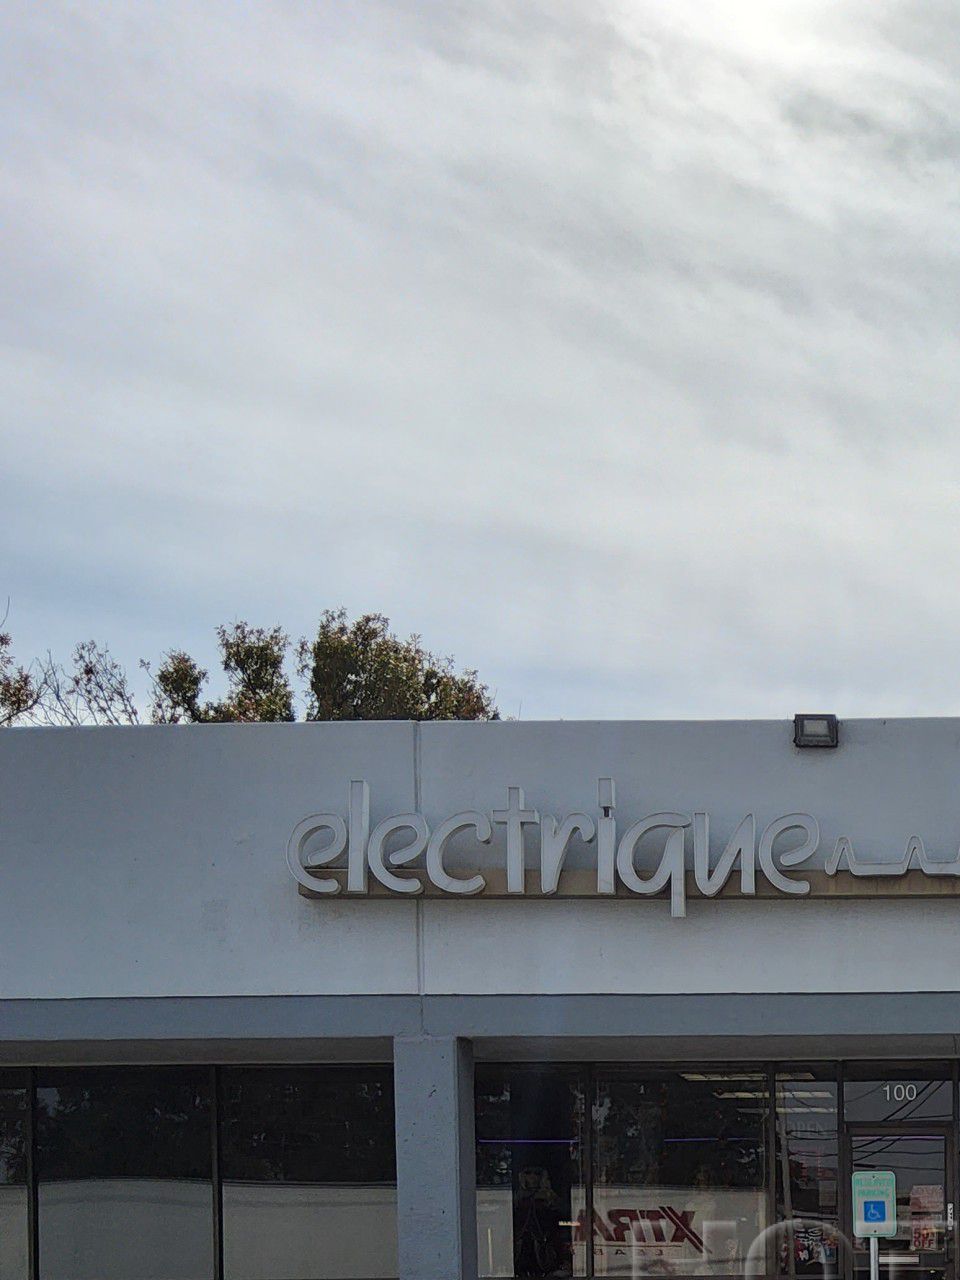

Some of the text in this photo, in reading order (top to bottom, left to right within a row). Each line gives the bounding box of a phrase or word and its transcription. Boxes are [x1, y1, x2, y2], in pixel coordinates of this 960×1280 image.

[286, 778, 820, 918] electrique
[882, 1084, 917, 1101] 100
[914, 1239, 934, 1248] OFF
